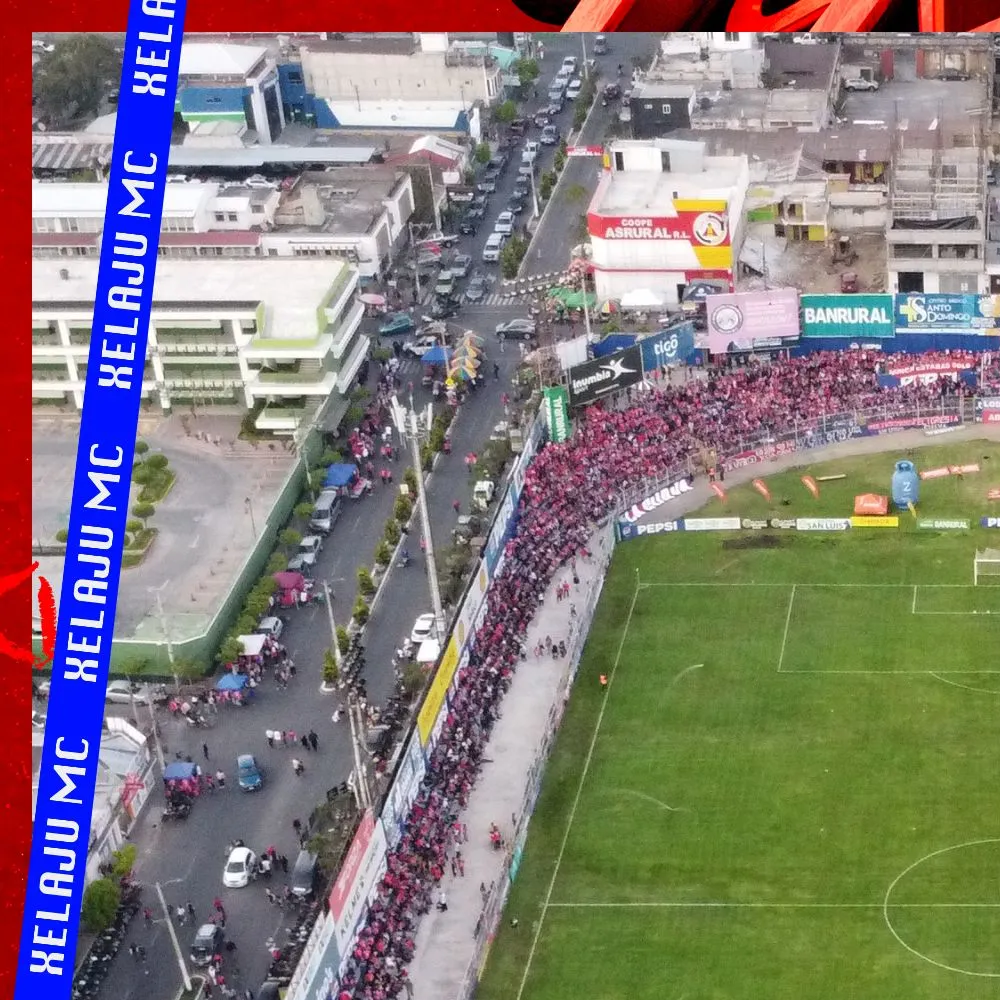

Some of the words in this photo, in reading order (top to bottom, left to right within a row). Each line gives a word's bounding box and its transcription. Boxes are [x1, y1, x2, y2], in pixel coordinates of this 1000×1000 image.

[621, 219, 652, 227] COOPE
[605, 228, 672, 239] ASRURAL
[805, 307, 891, 325] BANRURAL
[654, 333, 679, 357] tigo
[637, 521, 678, 535] PEPSI
